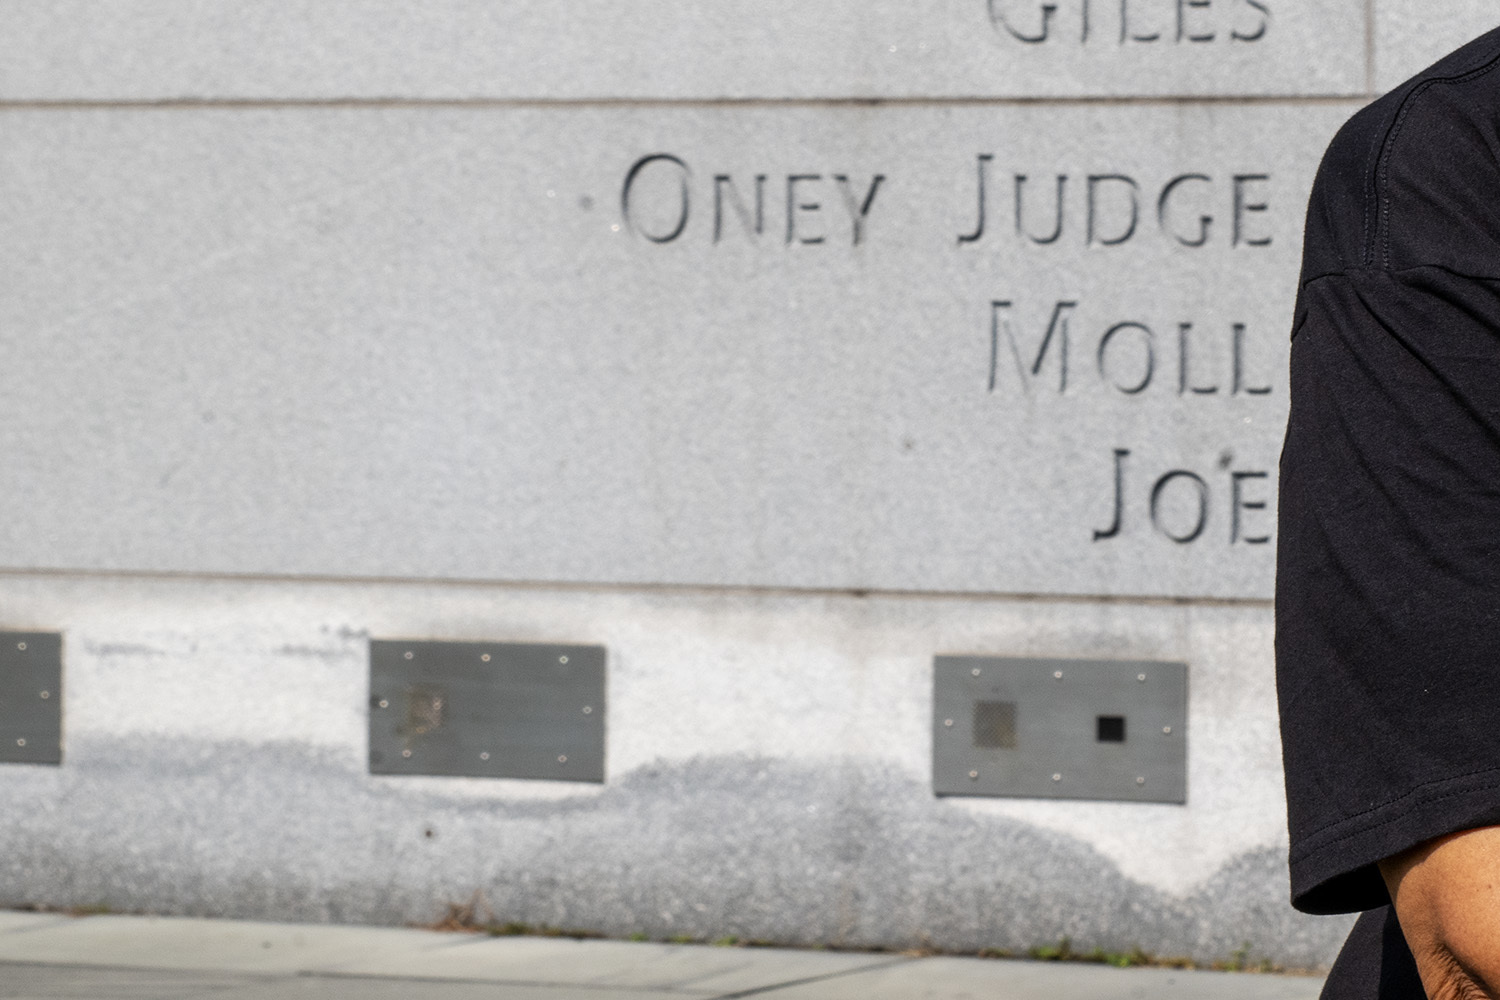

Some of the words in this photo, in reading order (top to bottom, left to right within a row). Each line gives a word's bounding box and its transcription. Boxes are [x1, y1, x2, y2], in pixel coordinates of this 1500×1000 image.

[621, 153, 886, 245] ONEY
[957, 154, 1273, 247] JUDGE
[987, 301, 1273, 395] MOLL
[1093, 449, 1272, 545] JOE
